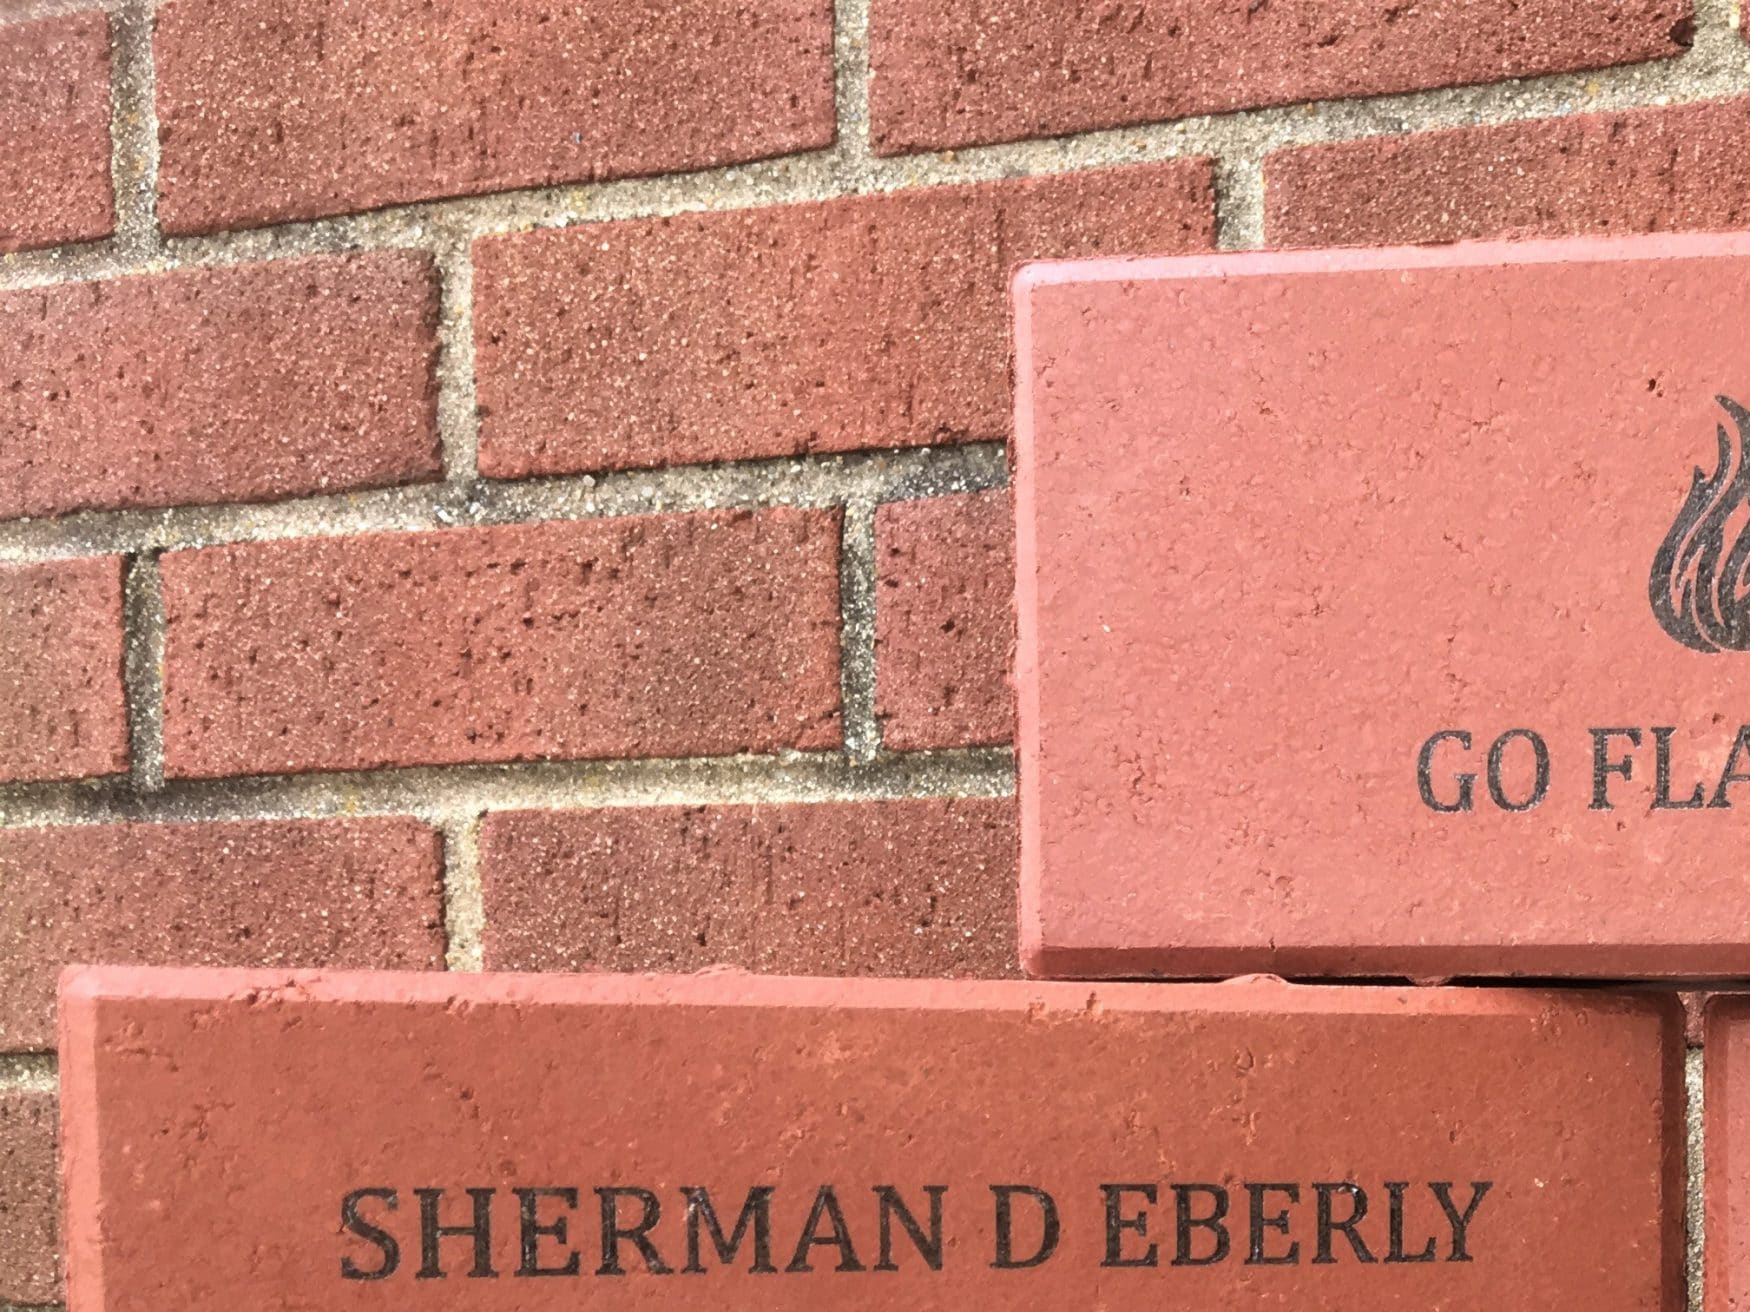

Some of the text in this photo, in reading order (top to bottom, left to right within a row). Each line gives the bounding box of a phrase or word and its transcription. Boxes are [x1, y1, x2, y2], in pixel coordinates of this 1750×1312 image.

[1418, 727, 1551, 813] GO
[341, 1178, 1493, 1282] SHERMAN D EBERLY
